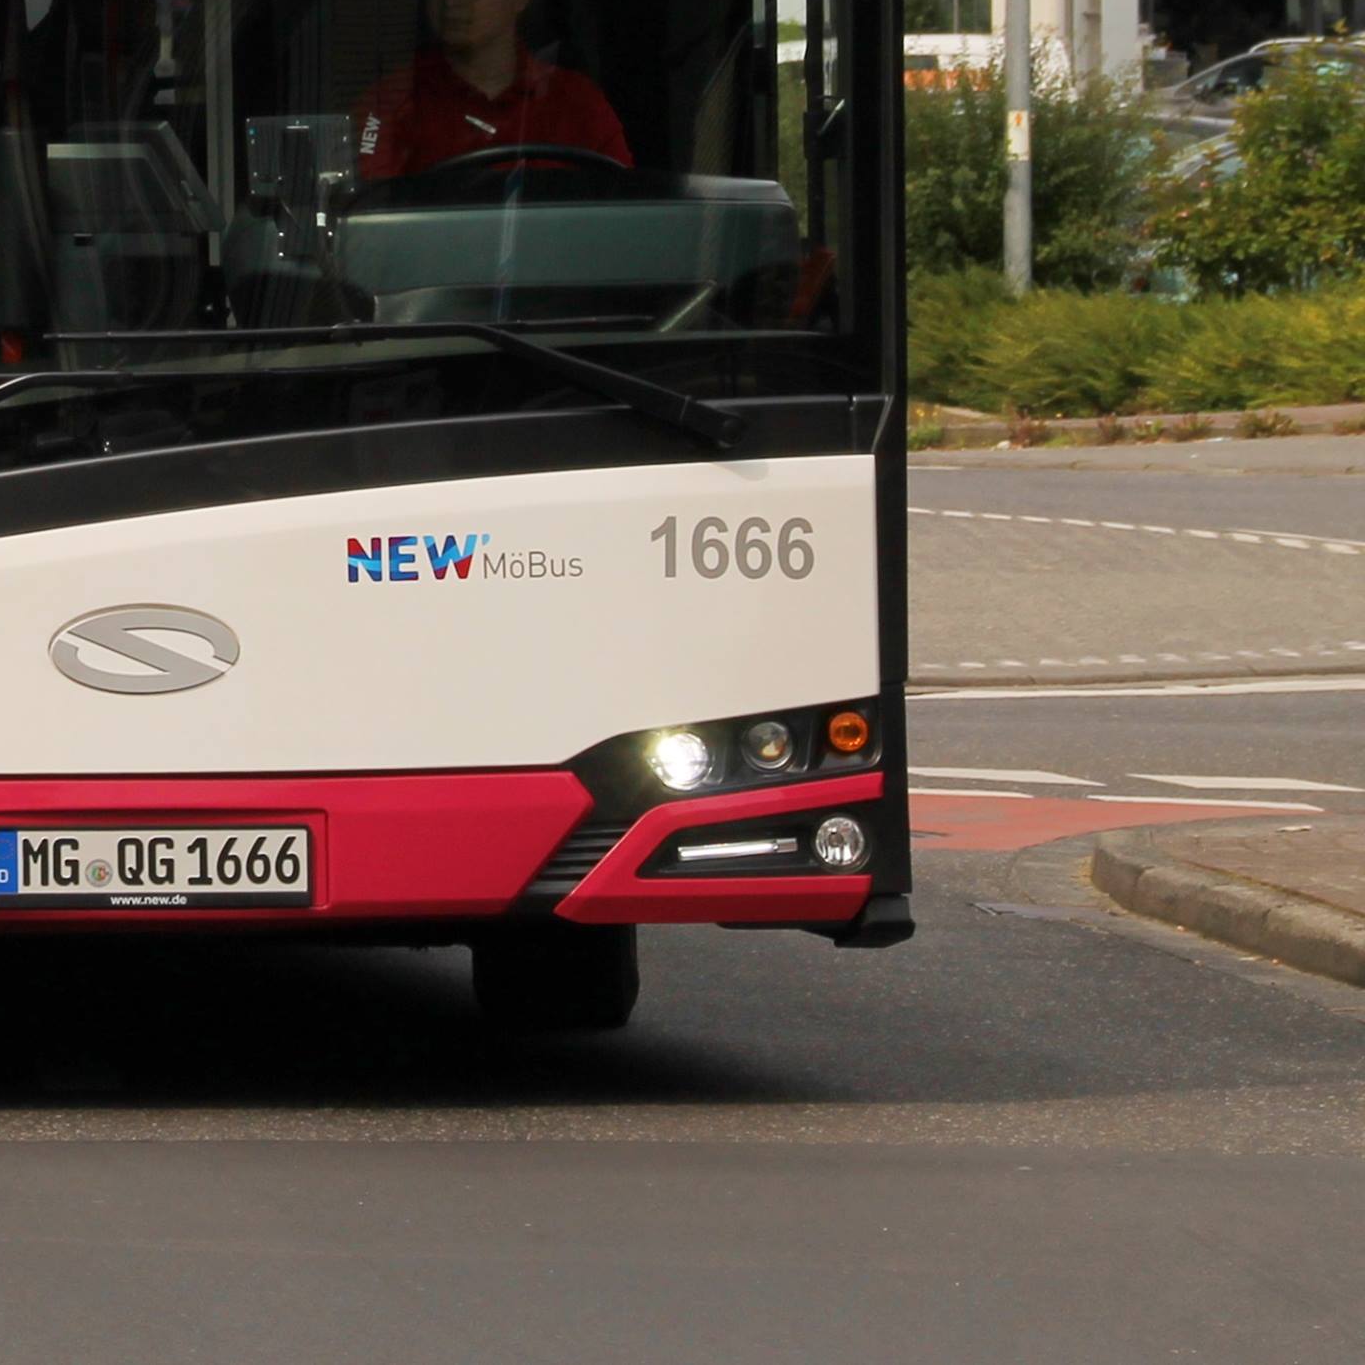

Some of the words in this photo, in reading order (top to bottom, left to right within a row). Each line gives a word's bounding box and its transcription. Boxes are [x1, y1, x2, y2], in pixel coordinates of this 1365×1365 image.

[482, 550, 584, 580] MöBus
[650, 515, 816, 581] 1666
[22, 838, 80, 887] MG
[116, 837, 175, 886] QG
[187, 836, 301, 886] 1666
[110, 893, 188, 907] www.new.de
